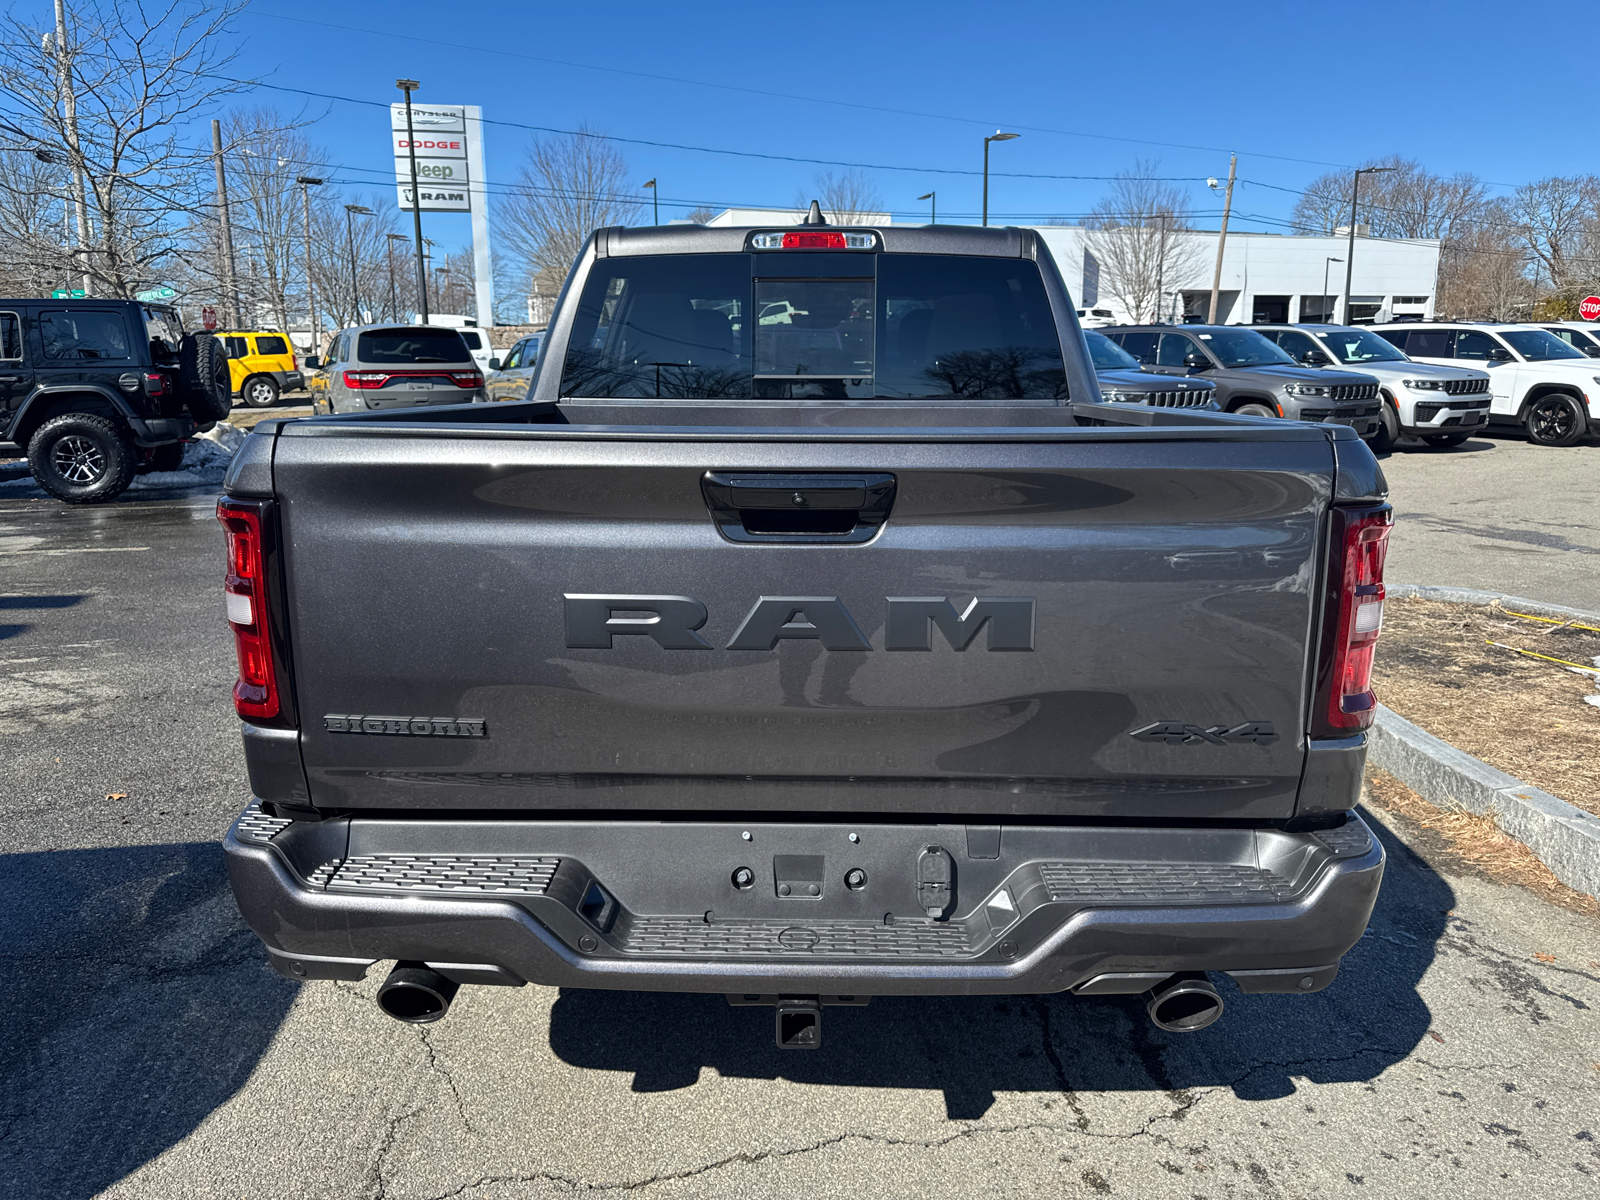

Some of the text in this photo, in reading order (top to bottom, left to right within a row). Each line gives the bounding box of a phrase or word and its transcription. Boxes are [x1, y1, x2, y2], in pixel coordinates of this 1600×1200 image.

[398, 140, 461, 150] DODGE
[420, 192, 464, 202] RAM
[203, 312, 216, 324] STOP
[563, 593, 1037, 651] RAM
[324, 714, 487, 739] BIGHORN
